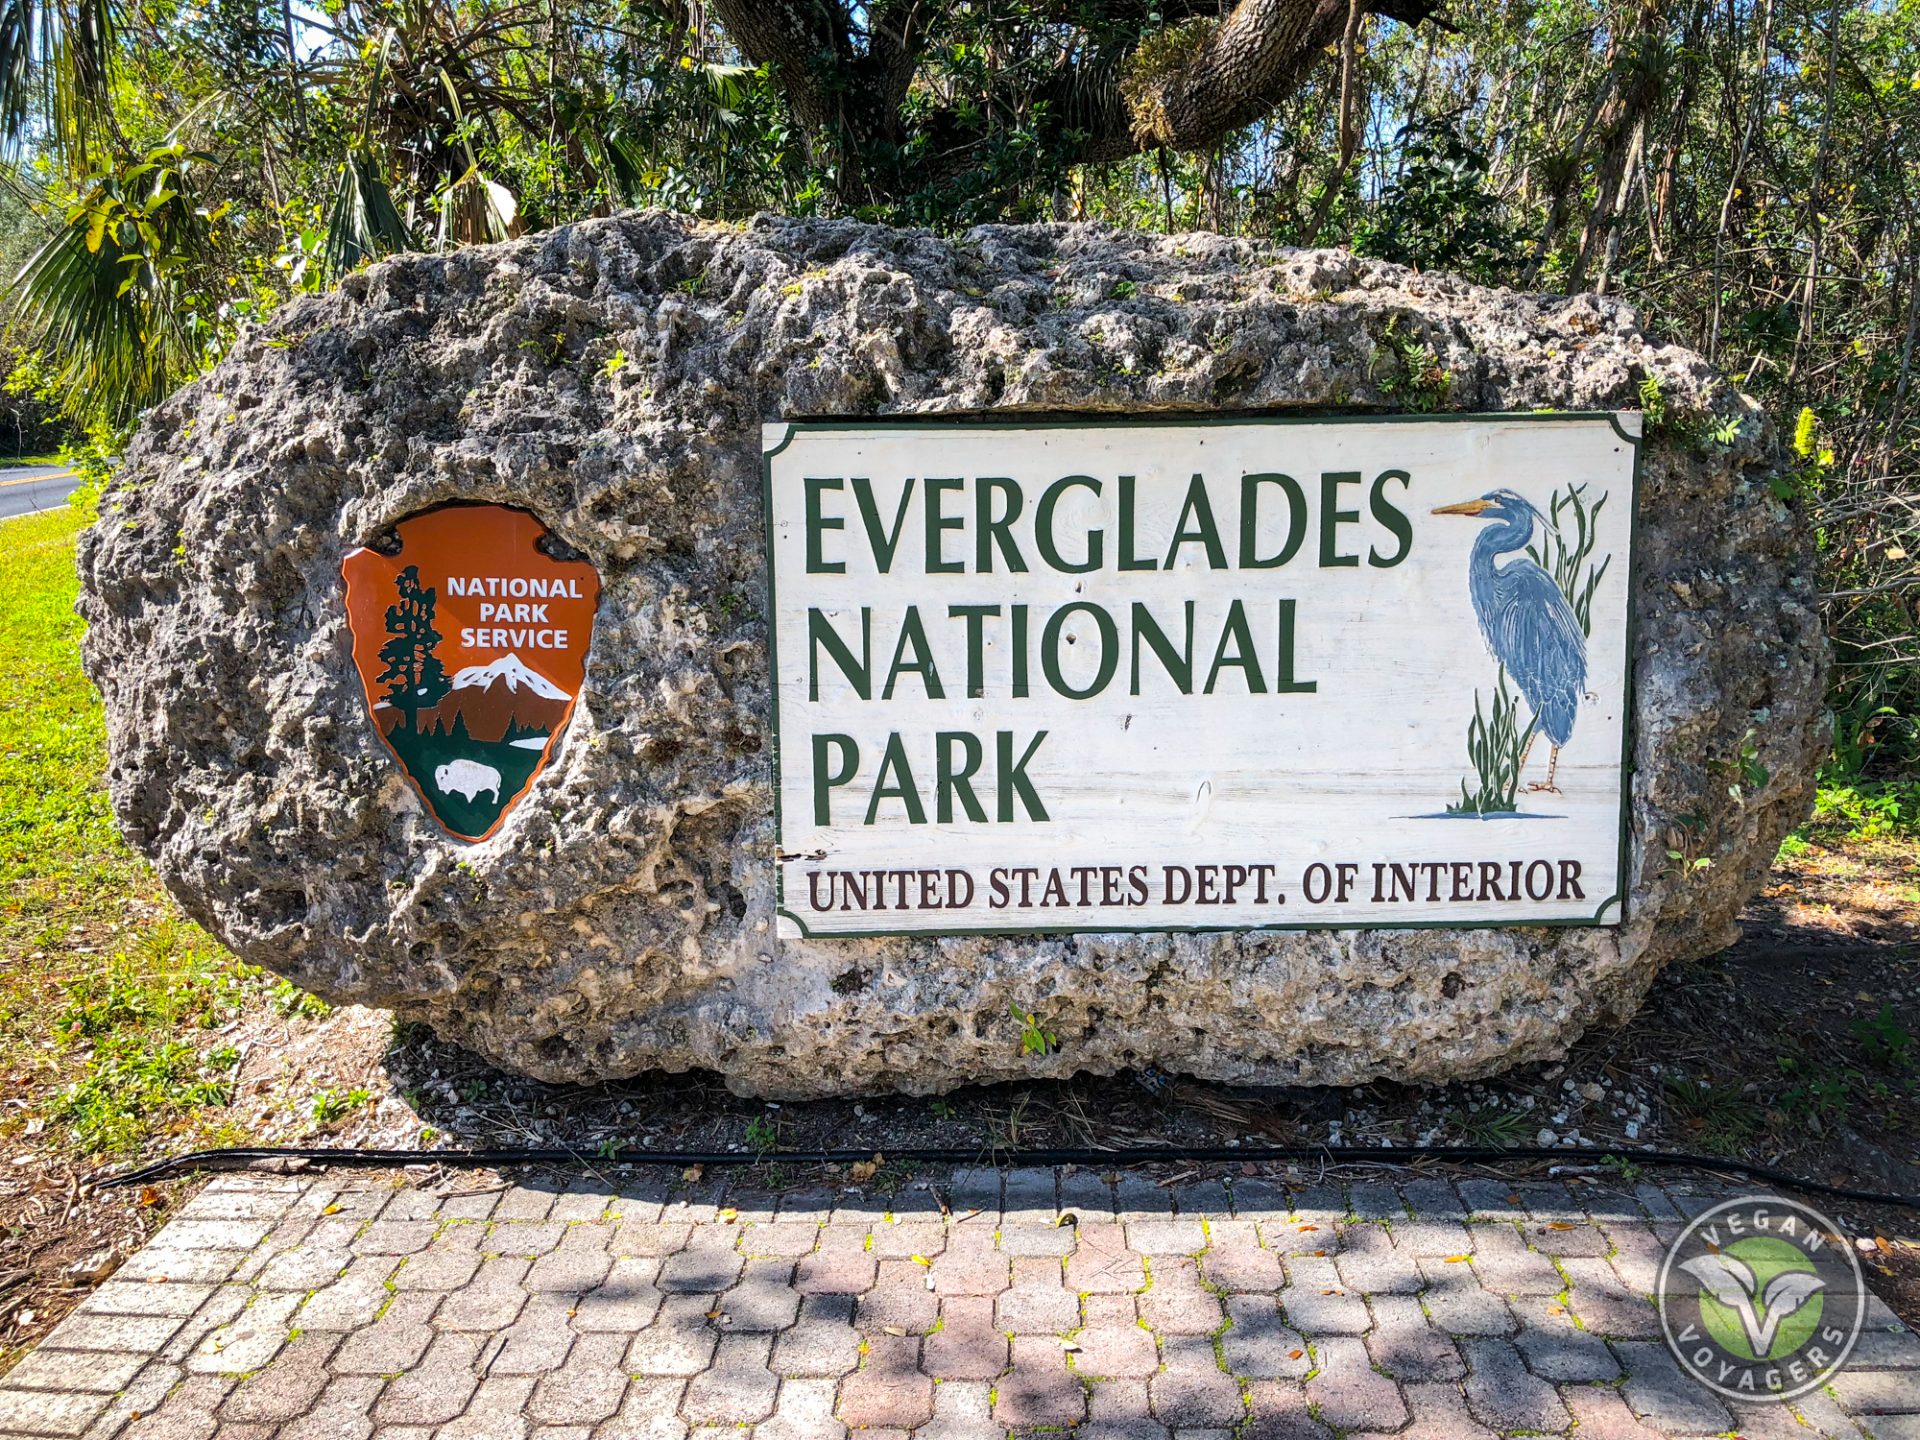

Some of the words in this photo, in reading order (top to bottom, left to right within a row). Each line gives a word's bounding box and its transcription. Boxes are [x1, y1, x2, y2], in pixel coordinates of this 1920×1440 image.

[803, 469, 1414, 574] EVERGLADES
[447, 577, 584, 599] NATIONAL
[479, 603, 549, 623] PARK
[460, 628, 568, 649] SERVICE
[807, 599, 1318, 702] NATIONAL
[812, 730, 1051, 827] PARK
[807, 869, 975, 912] UNITED
[989, 865, 1149, 909] STATES
[1162, 863, 1286, 906] DEPT.
[1303, 862, 1359, 904] OF
[1371, 859, 1586, 903] INTERIOR
